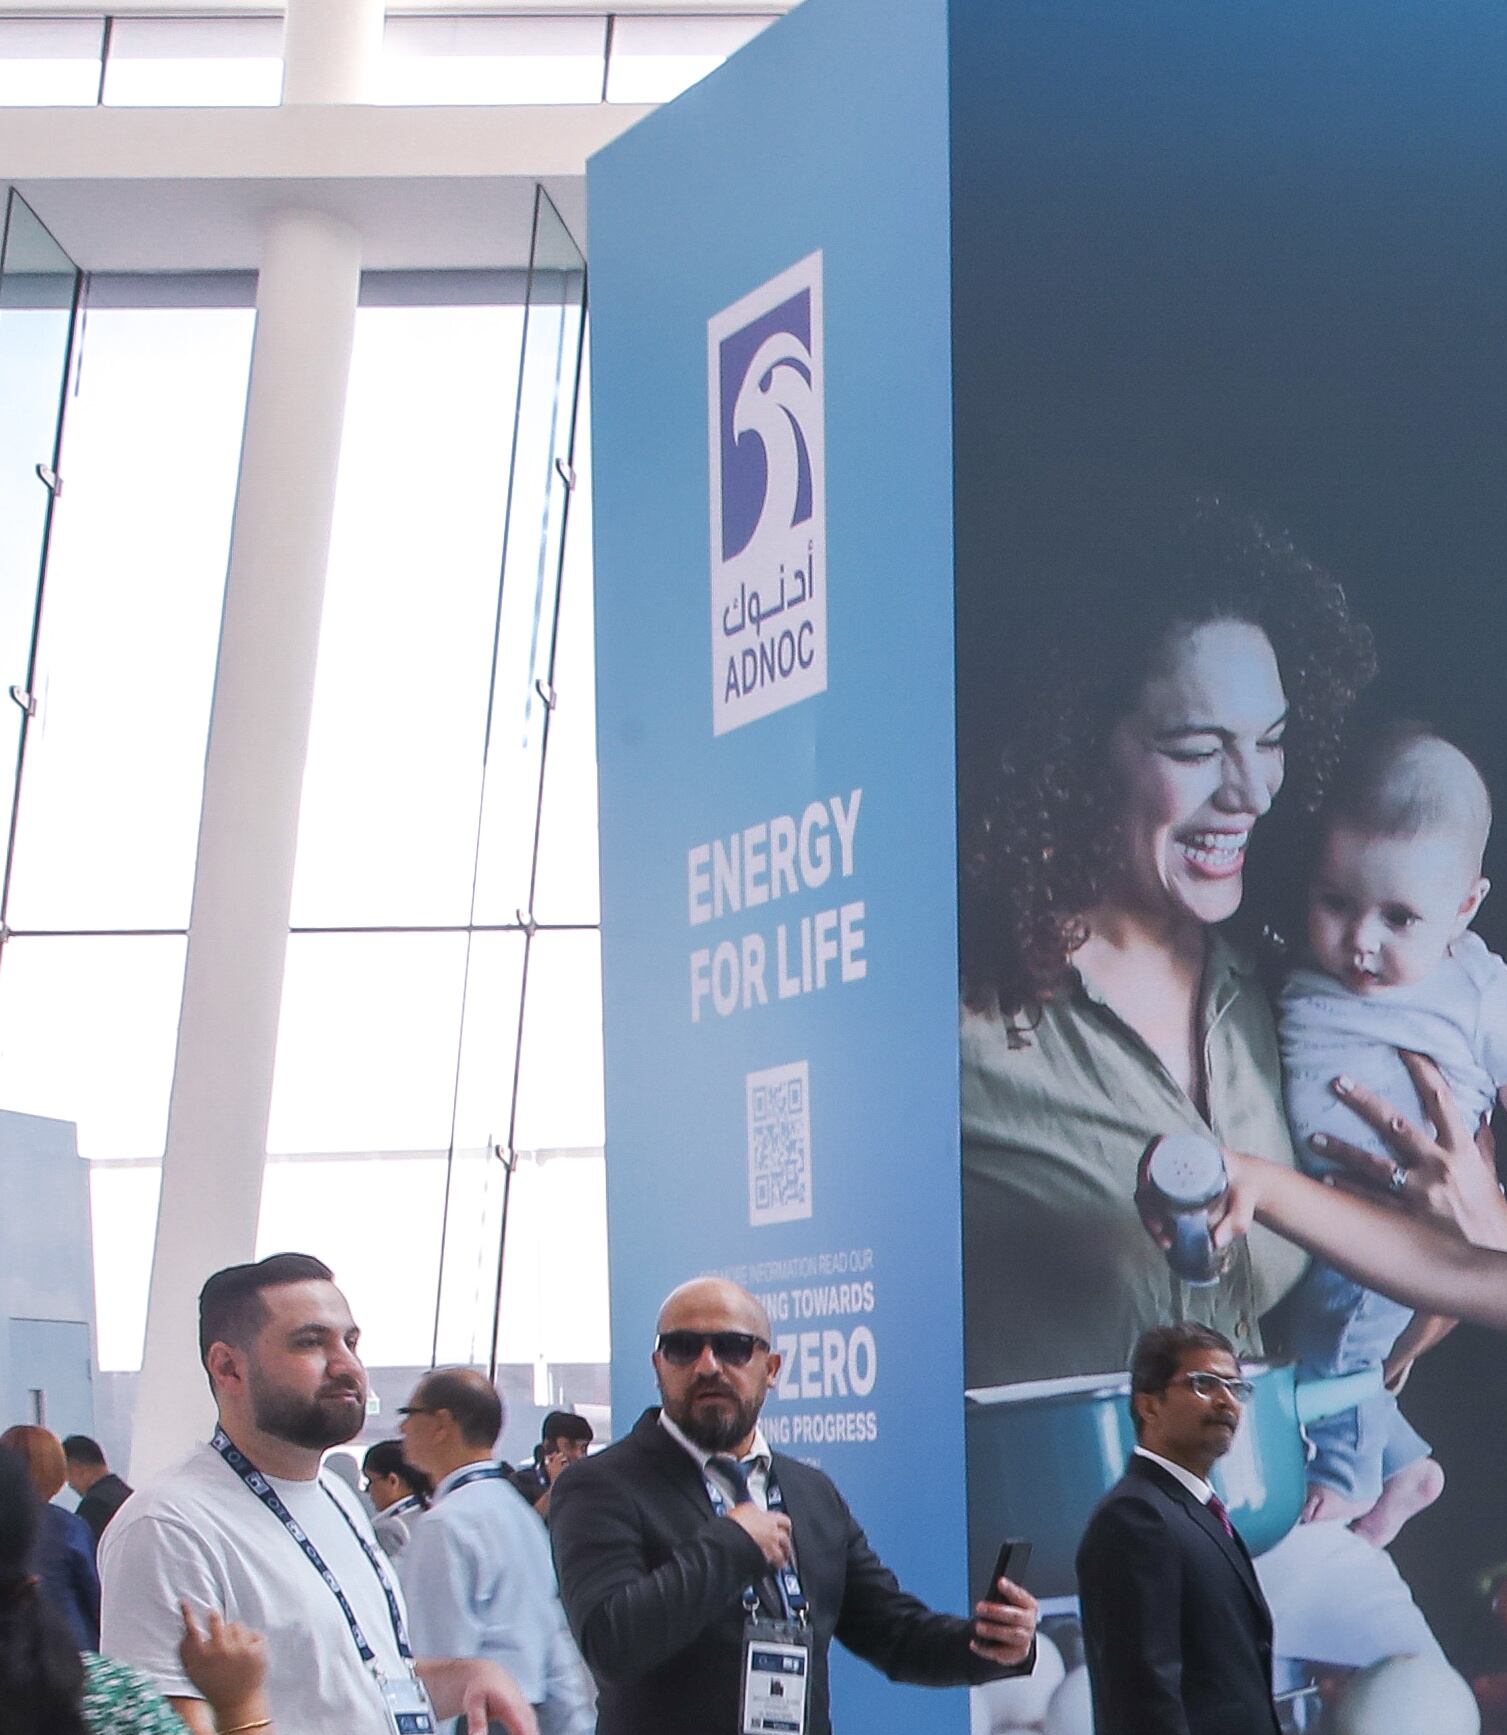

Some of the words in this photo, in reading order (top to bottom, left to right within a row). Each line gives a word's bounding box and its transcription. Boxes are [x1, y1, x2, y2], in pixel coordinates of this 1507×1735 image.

[724, 619, 815, 703] ADNOC
[688, 788, 863, 926] ENERGY
[690, 932, 769, 1023] FOR
[776, 900, 867, 999] LIFE
[791, 1281, 875, 1318] TOWARDS
[819, 1252, 848, 1275] READ
[850, 1249, 873, 1272] OUR
[776, 1325, 877, 1400] ZERO
[792, 1411, 877, 1443] PROGRESS
